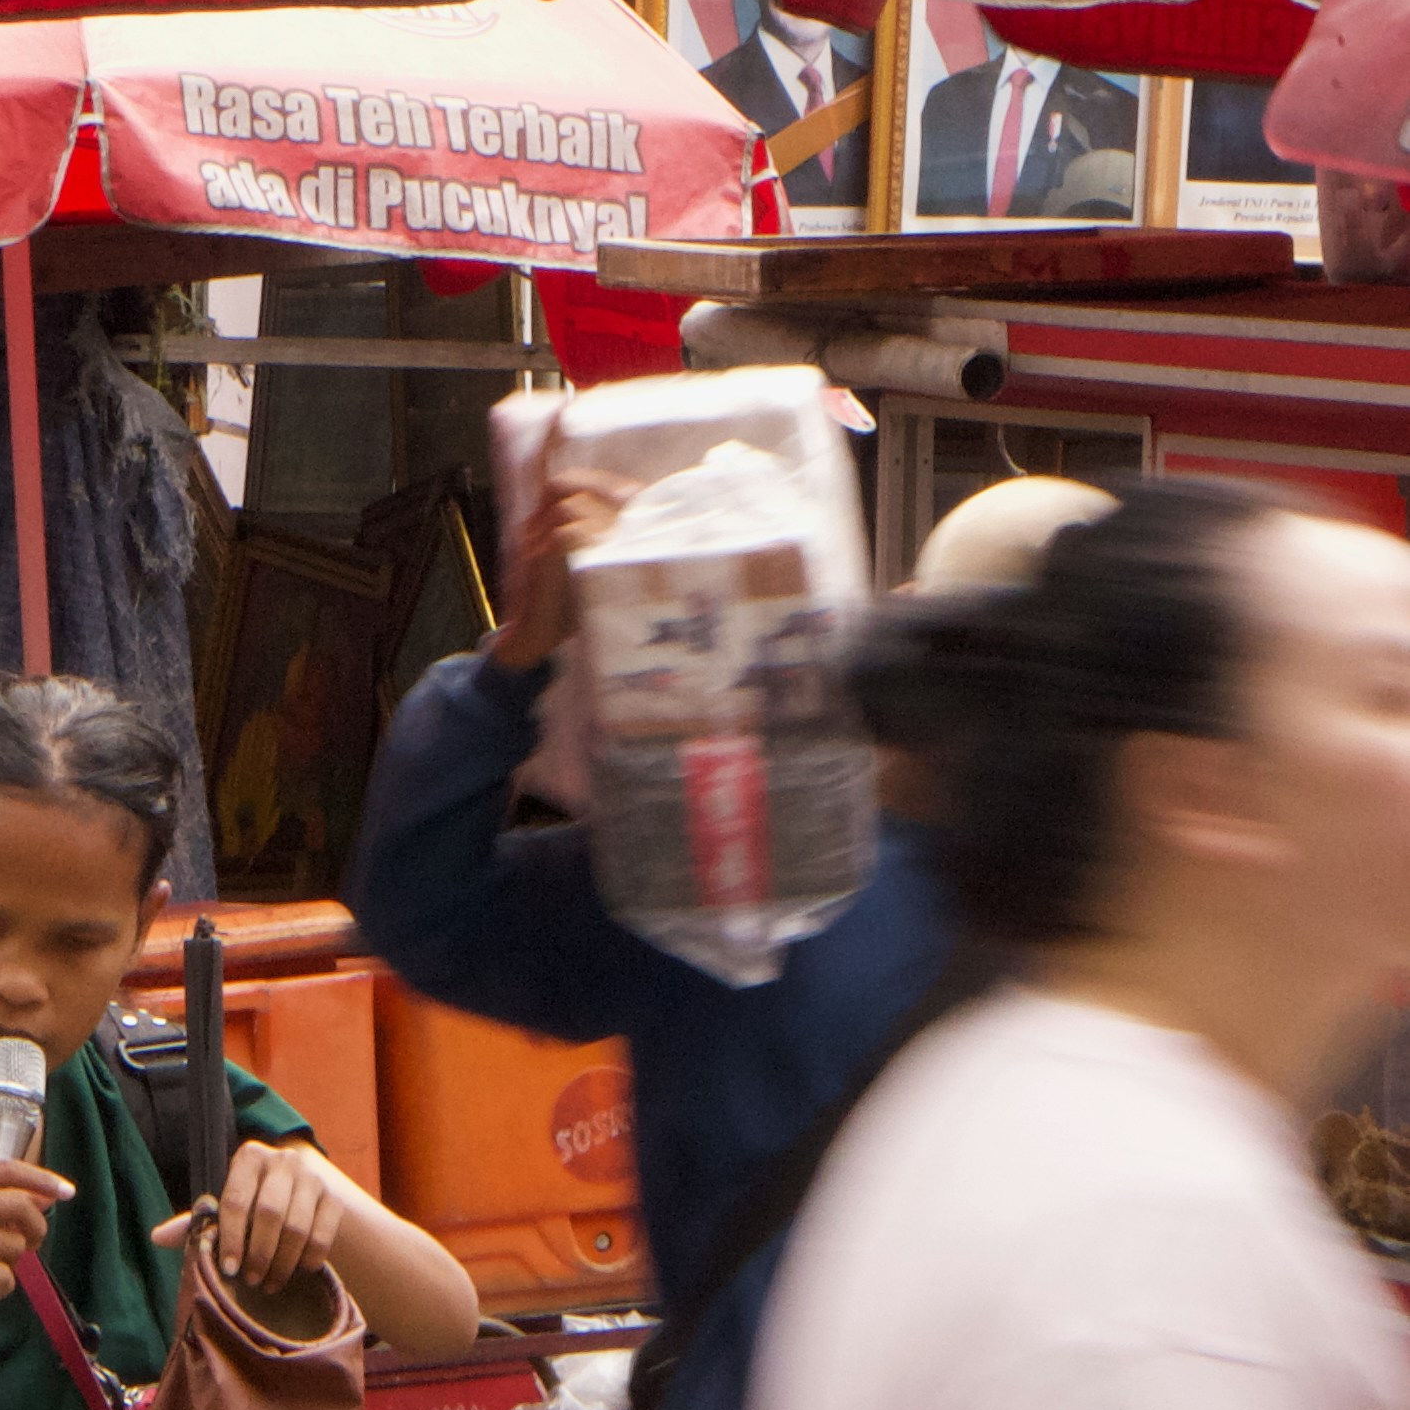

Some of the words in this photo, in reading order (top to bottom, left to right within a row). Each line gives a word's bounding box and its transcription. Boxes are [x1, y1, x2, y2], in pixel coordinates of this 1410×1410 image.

[179, 74, 321, 144] Rasa
[324, 87, 431, 148] Teh
[434, 95, 644, 174] Terbaik
[200, 160, 298, 217] ada
[300, 166, 357, 229] di
[369, 167, 647, 252] Pucuknya!
